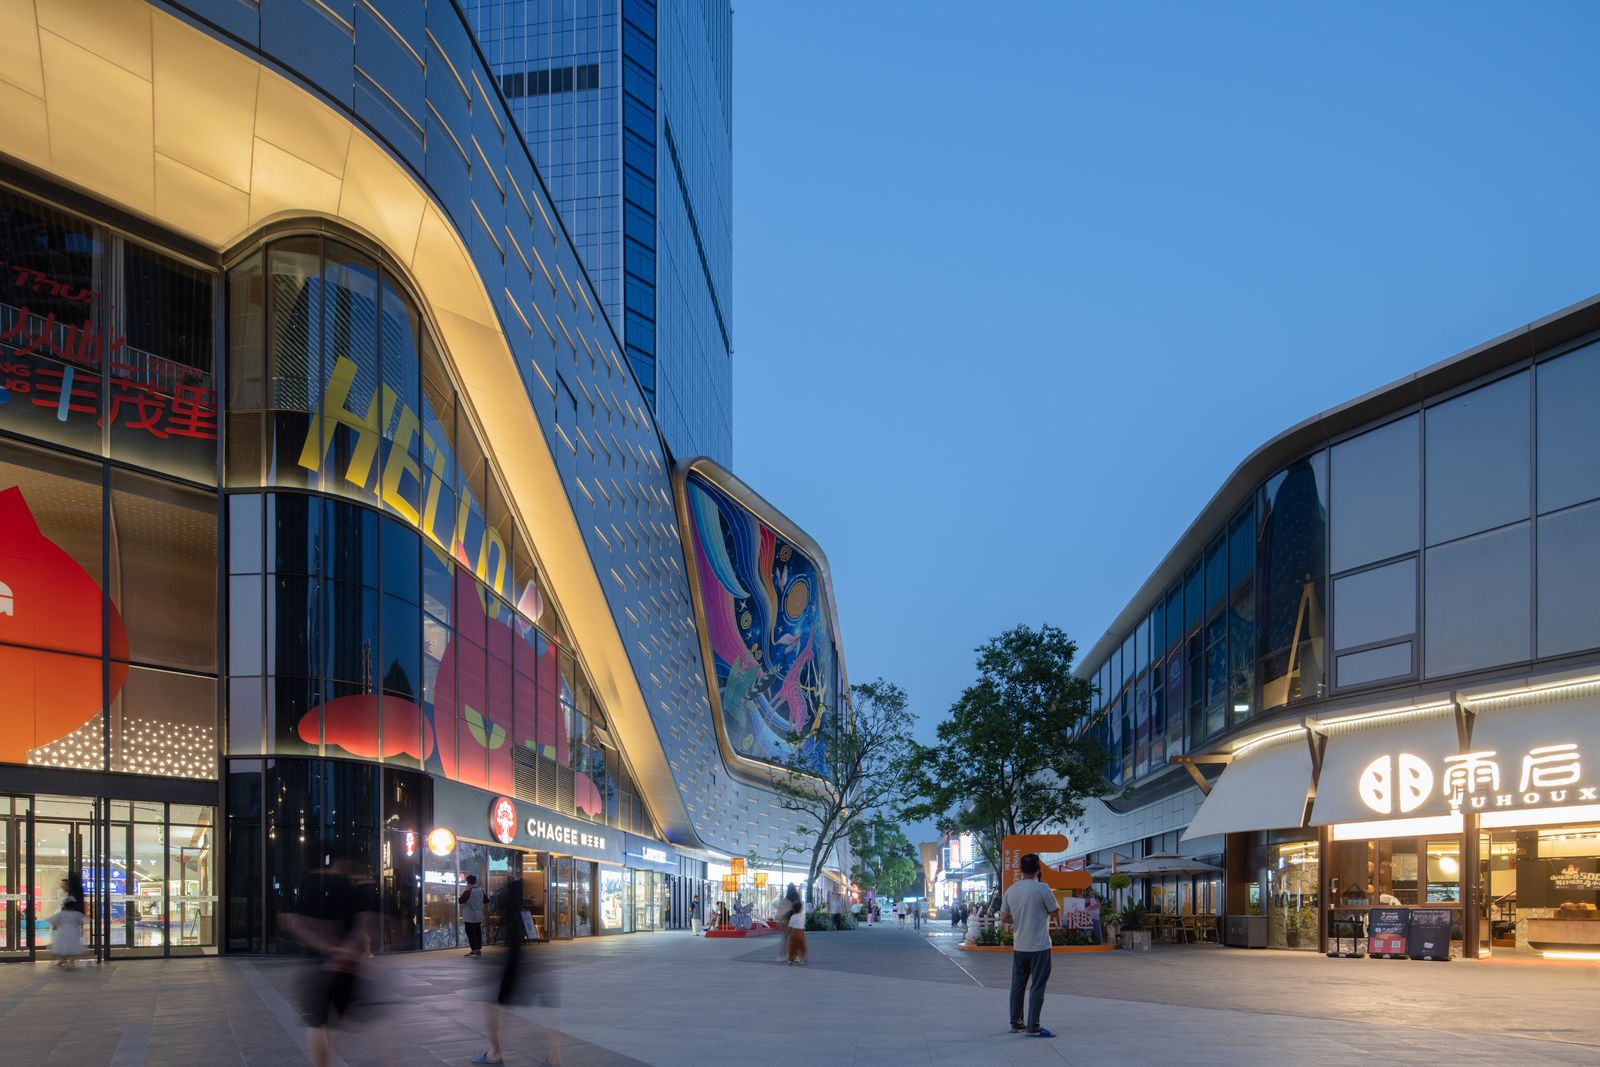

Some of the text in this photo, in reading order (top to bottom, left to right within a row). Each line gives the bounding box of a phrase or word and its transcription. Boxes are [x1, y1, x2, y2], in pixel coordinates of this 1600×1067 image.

[32, 367, 219, 440] 丰茂里
[1443, 743, 1581, 796] 雨后
[527, 818, 579, 846] CHAGEE
